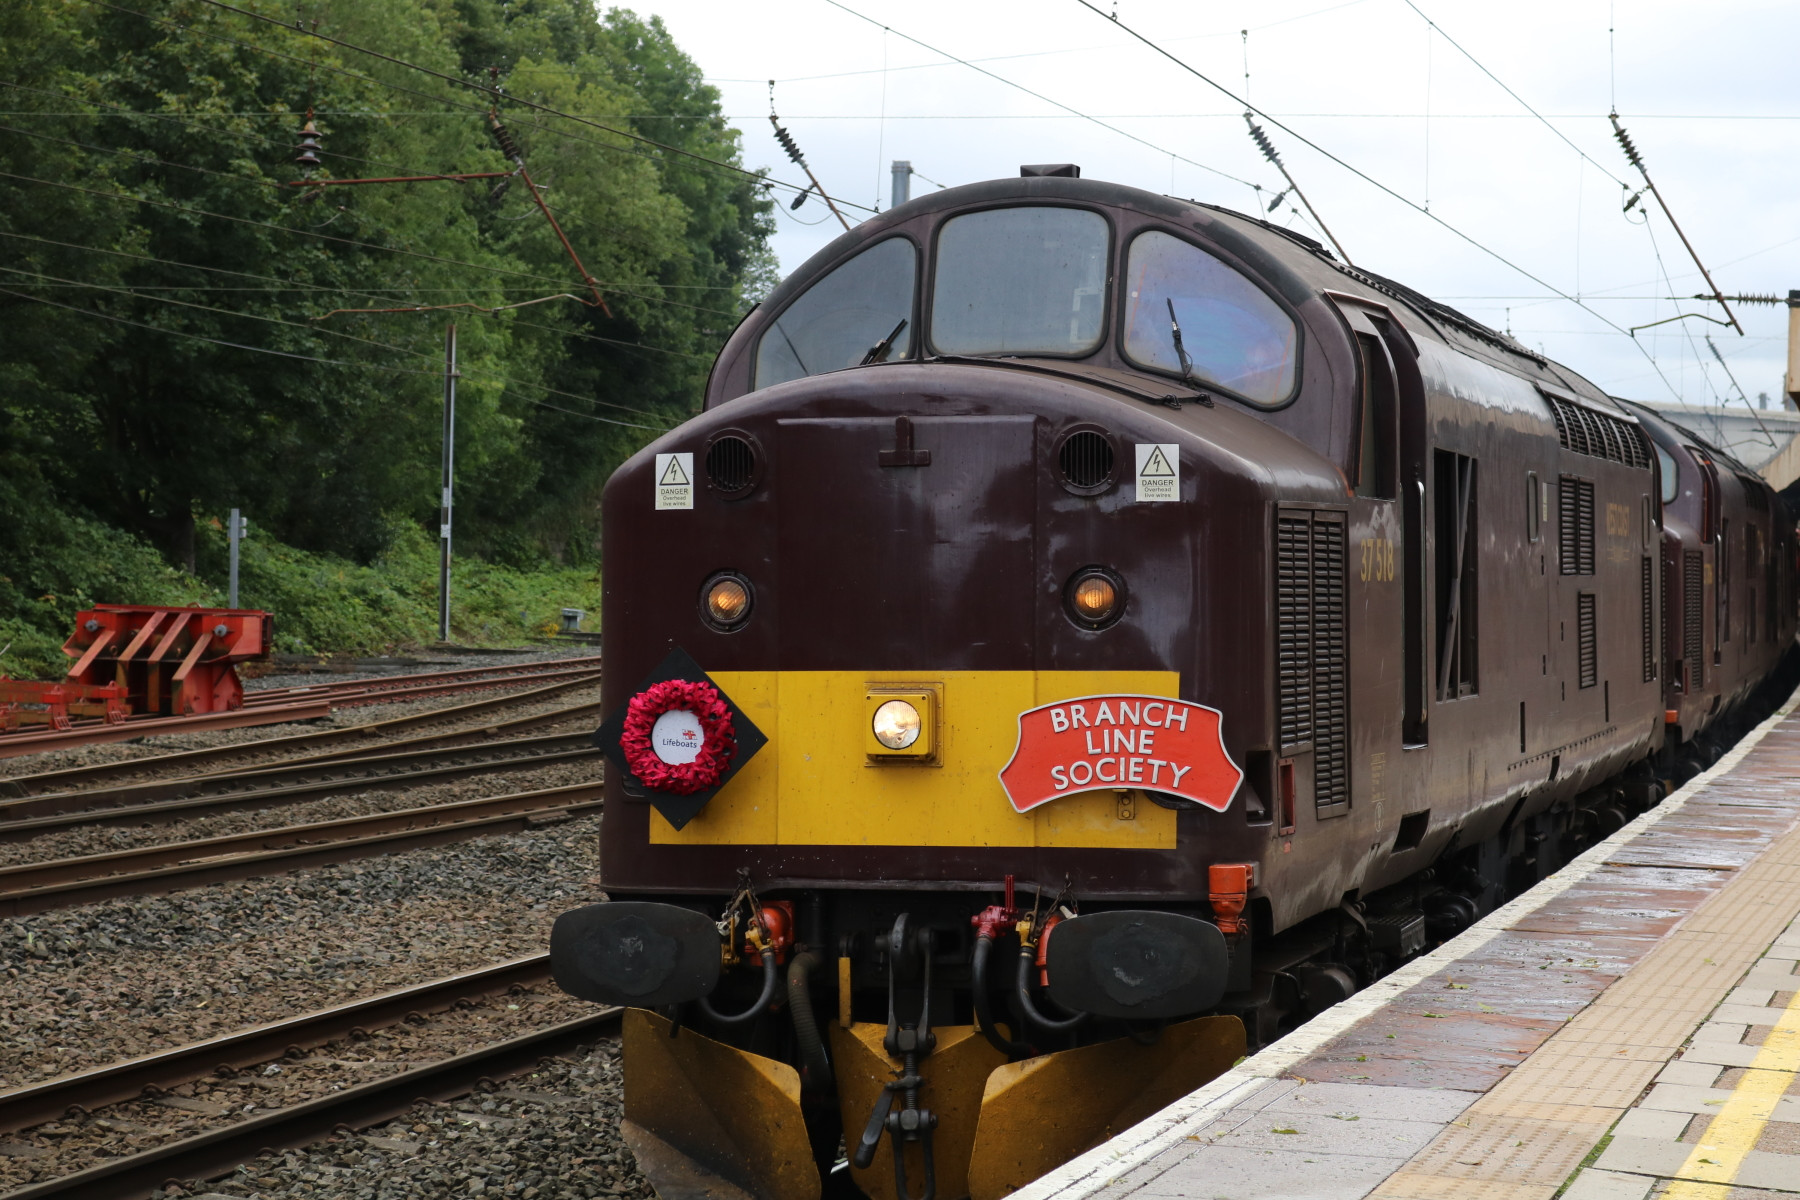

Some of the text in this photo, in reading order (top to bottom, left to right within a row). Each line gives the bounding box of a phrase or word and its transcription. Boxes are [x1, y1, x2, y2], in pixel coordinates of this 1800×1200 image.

[1049, 701, 1190, 733] BRANCH
[662, 738, 698, 748] Lifeboats
[1085, 729, 1155, 755] LINE
[1050, 757, 1192, 790] SOCIETY
